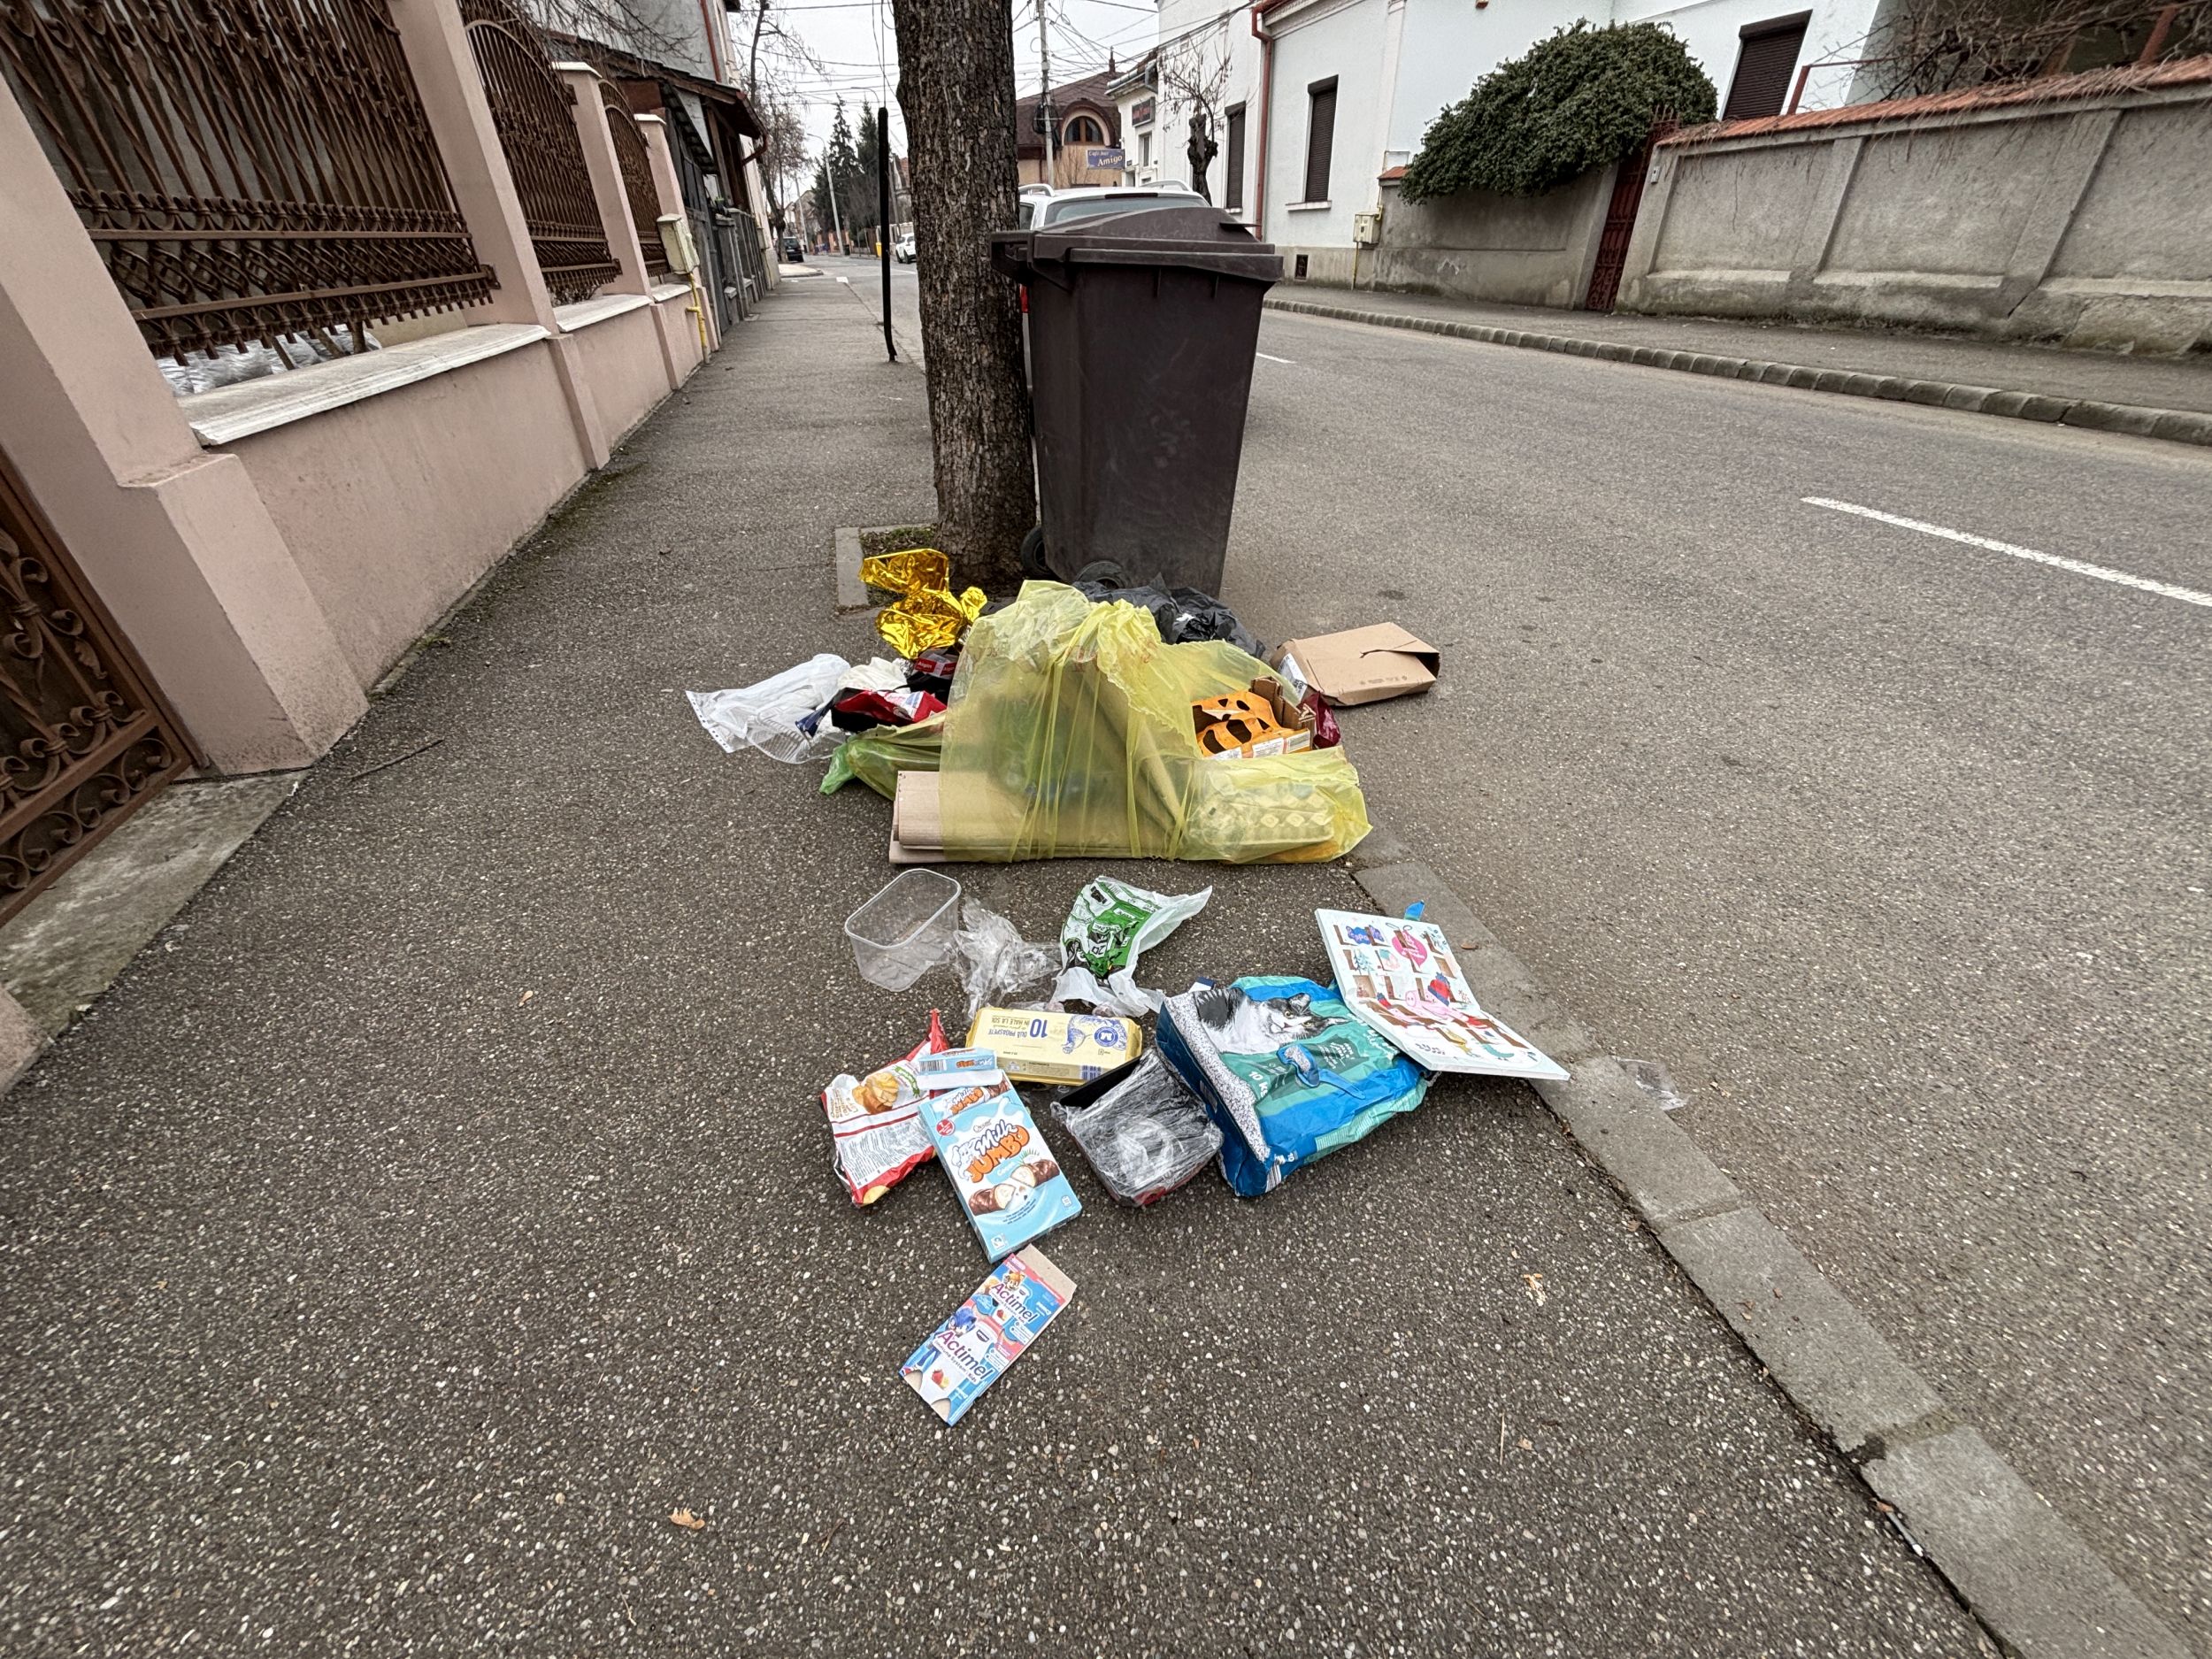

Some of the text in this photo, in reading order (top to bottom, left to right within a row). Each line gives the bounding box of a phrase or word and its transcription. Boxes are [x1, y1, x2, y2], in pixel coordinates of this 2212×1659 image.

[1097, 155, 1123, 166] Amigo
[1029, 1018, 1048, 1039] 10
[1248, 1070, 1263, 1081] 10
[950, 1086, 985, 1115] JUMBO
[952, 1086, 974, 1103] Milk
[974, 1118, 1018, 1156] Milk
[967, 1125, 1030, 1184] JUMBO
[991, 1282, 1039, 1324] Actimel
[937, 1330, 995, 1380] Actimel
[949, 1356, 969, 1374] System
[967, 1371, 978, 1383] Kids
